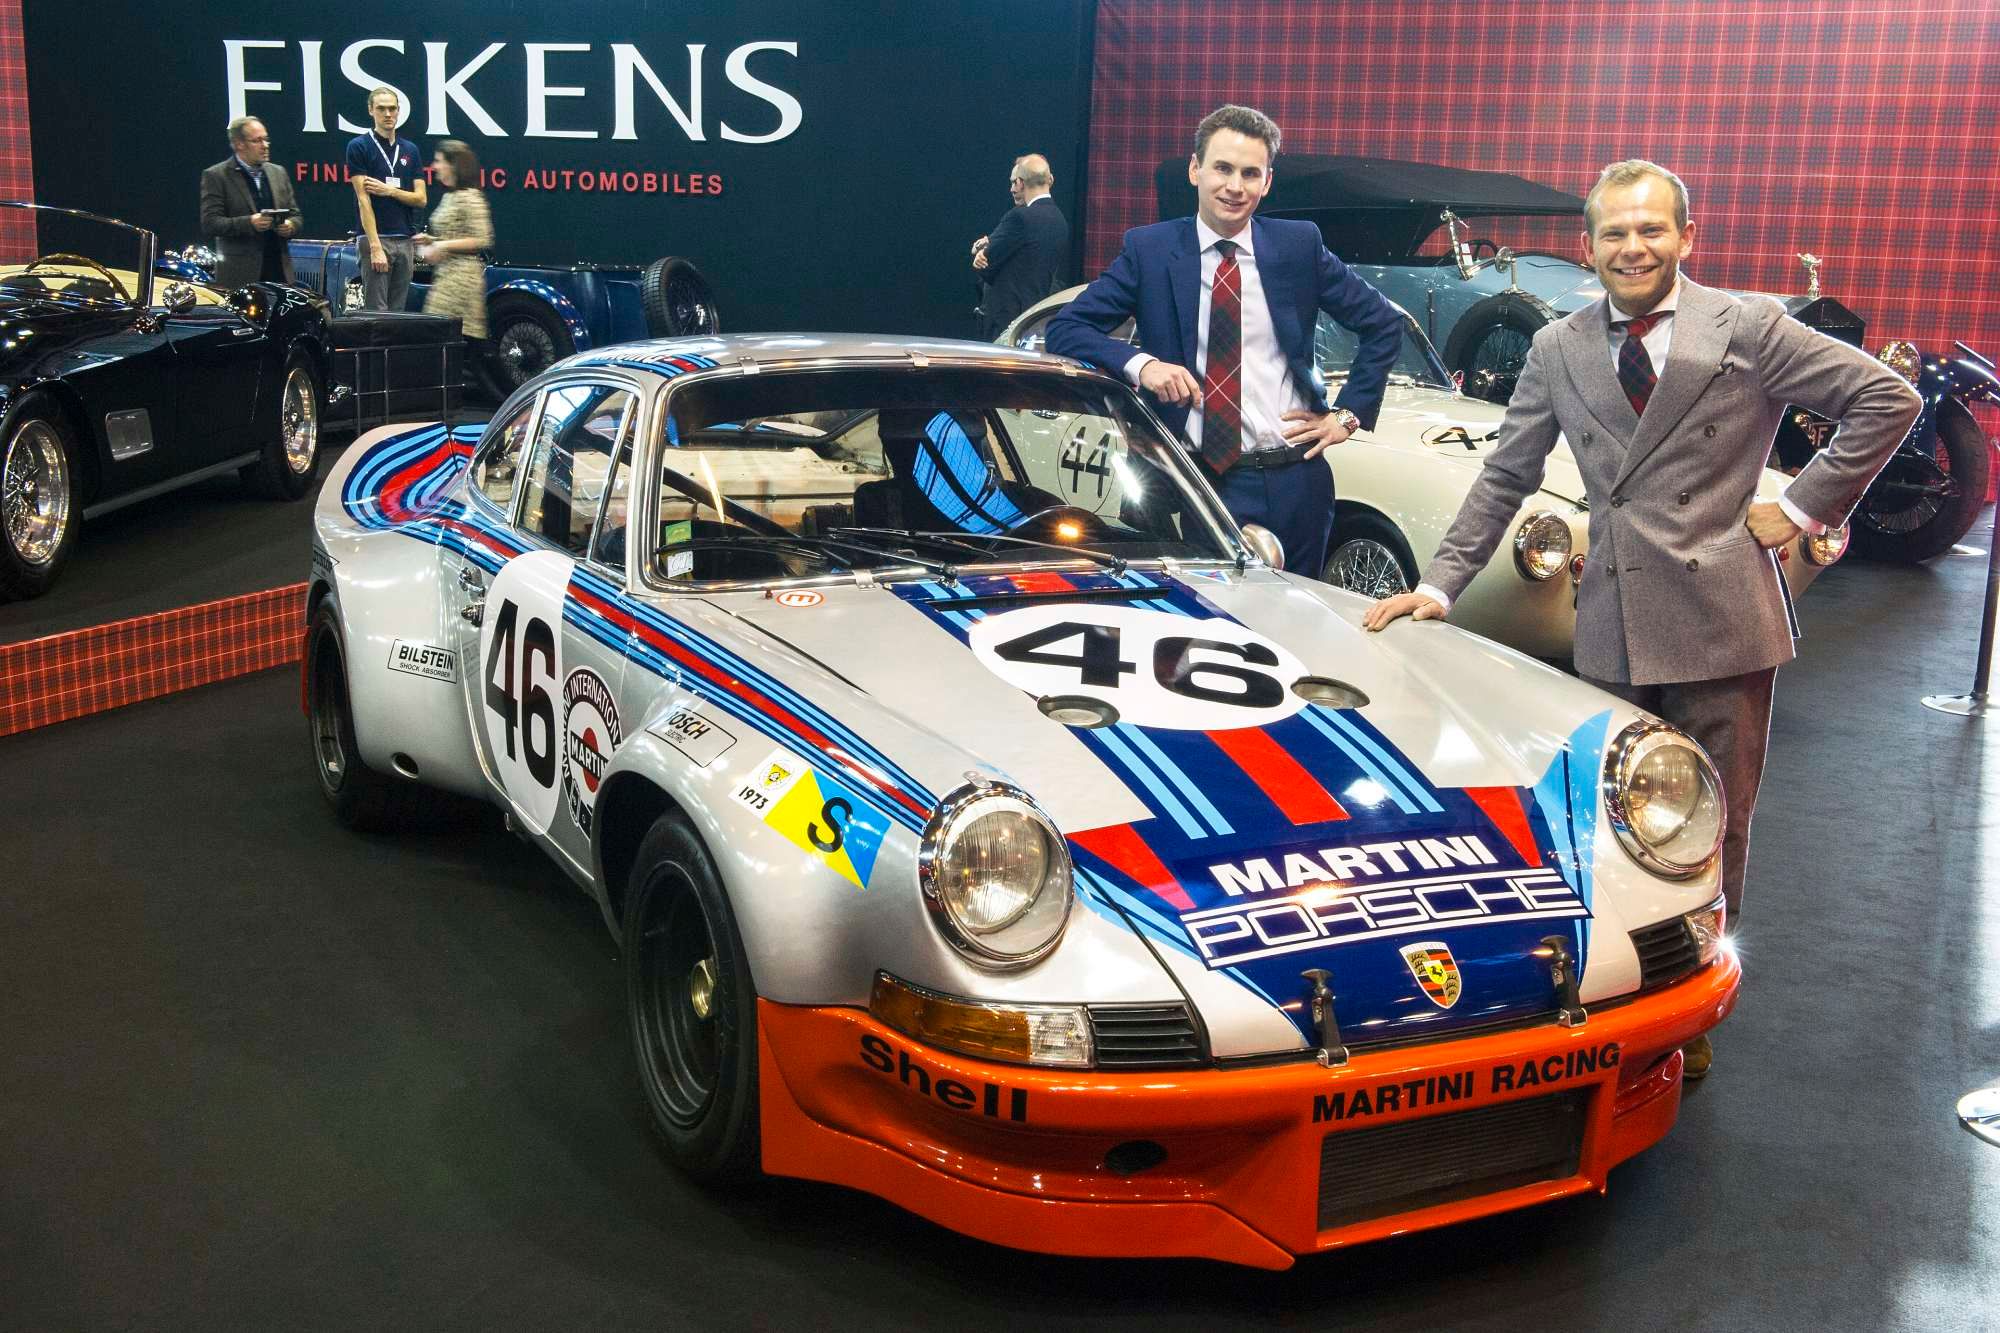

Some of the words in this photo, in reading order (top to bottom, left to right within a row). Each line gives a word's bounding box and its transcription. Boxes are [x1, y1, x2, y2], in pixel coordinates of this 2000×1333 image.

[222, 39, 803, 144] FISKENS
[523, 170, 723, 195] AUTOMOBILES
[1061, 426, 1111, 498] 44
[399, 645, 454, 671] BILSTEIN
[399, 662, 420, 672] SHOCK
[421, 668, 451, 678] ABSORBER
[485, 598, 556, 788] 46
[993, 621, 1285, 707] 46
[570, 673, 621, 747] INTERNATION
[570, 735, 608, 777] MARTIN
[738, 786, 769, 810] 1973
[807, 797, 854, 853] S
[1209, 835, 1498, 896] MARTINI
[1184, 873, 1588, 959] PORSCHE
[859, 1034, 1028, 1123] Shell
[1312, 1070, 1474, 1124] MARTINI
[1491, 1042, 1621, 1094] RACING
